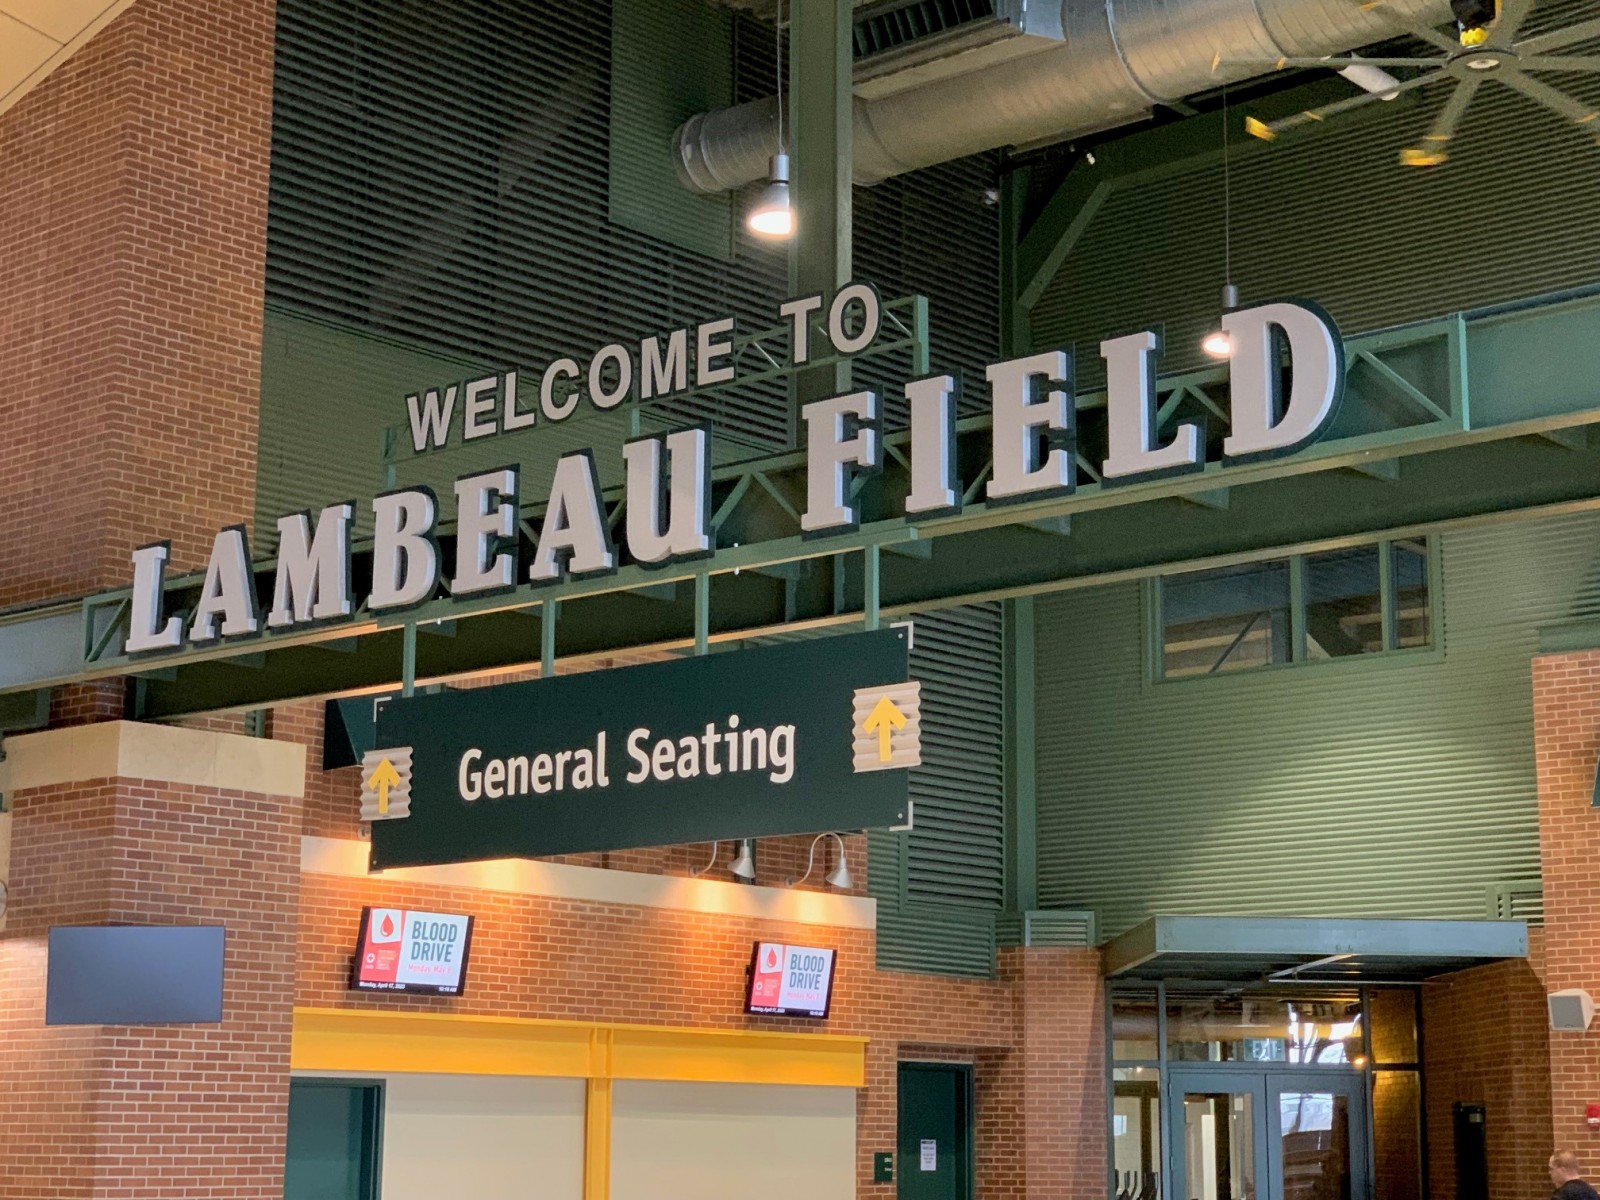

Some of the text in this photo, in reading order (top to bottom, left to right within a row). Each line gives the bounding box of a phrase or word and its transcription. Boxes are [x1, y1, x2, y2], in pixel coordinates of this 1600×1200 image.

[406, 283, 879, 452] WELCOME TO
[125, 302, 1338, 652] LAMBEAU FIELD
[458, 714, 796, 801] General Seating
[412, 921, 458, 942] BLOOD
[411, 942, 453, 962] DRIVE
[790, 953, 825, 973] BLOOD
[789, 972, 821, 990] DRIVE
[1252, 1040, 1278, 1059] EXIT
